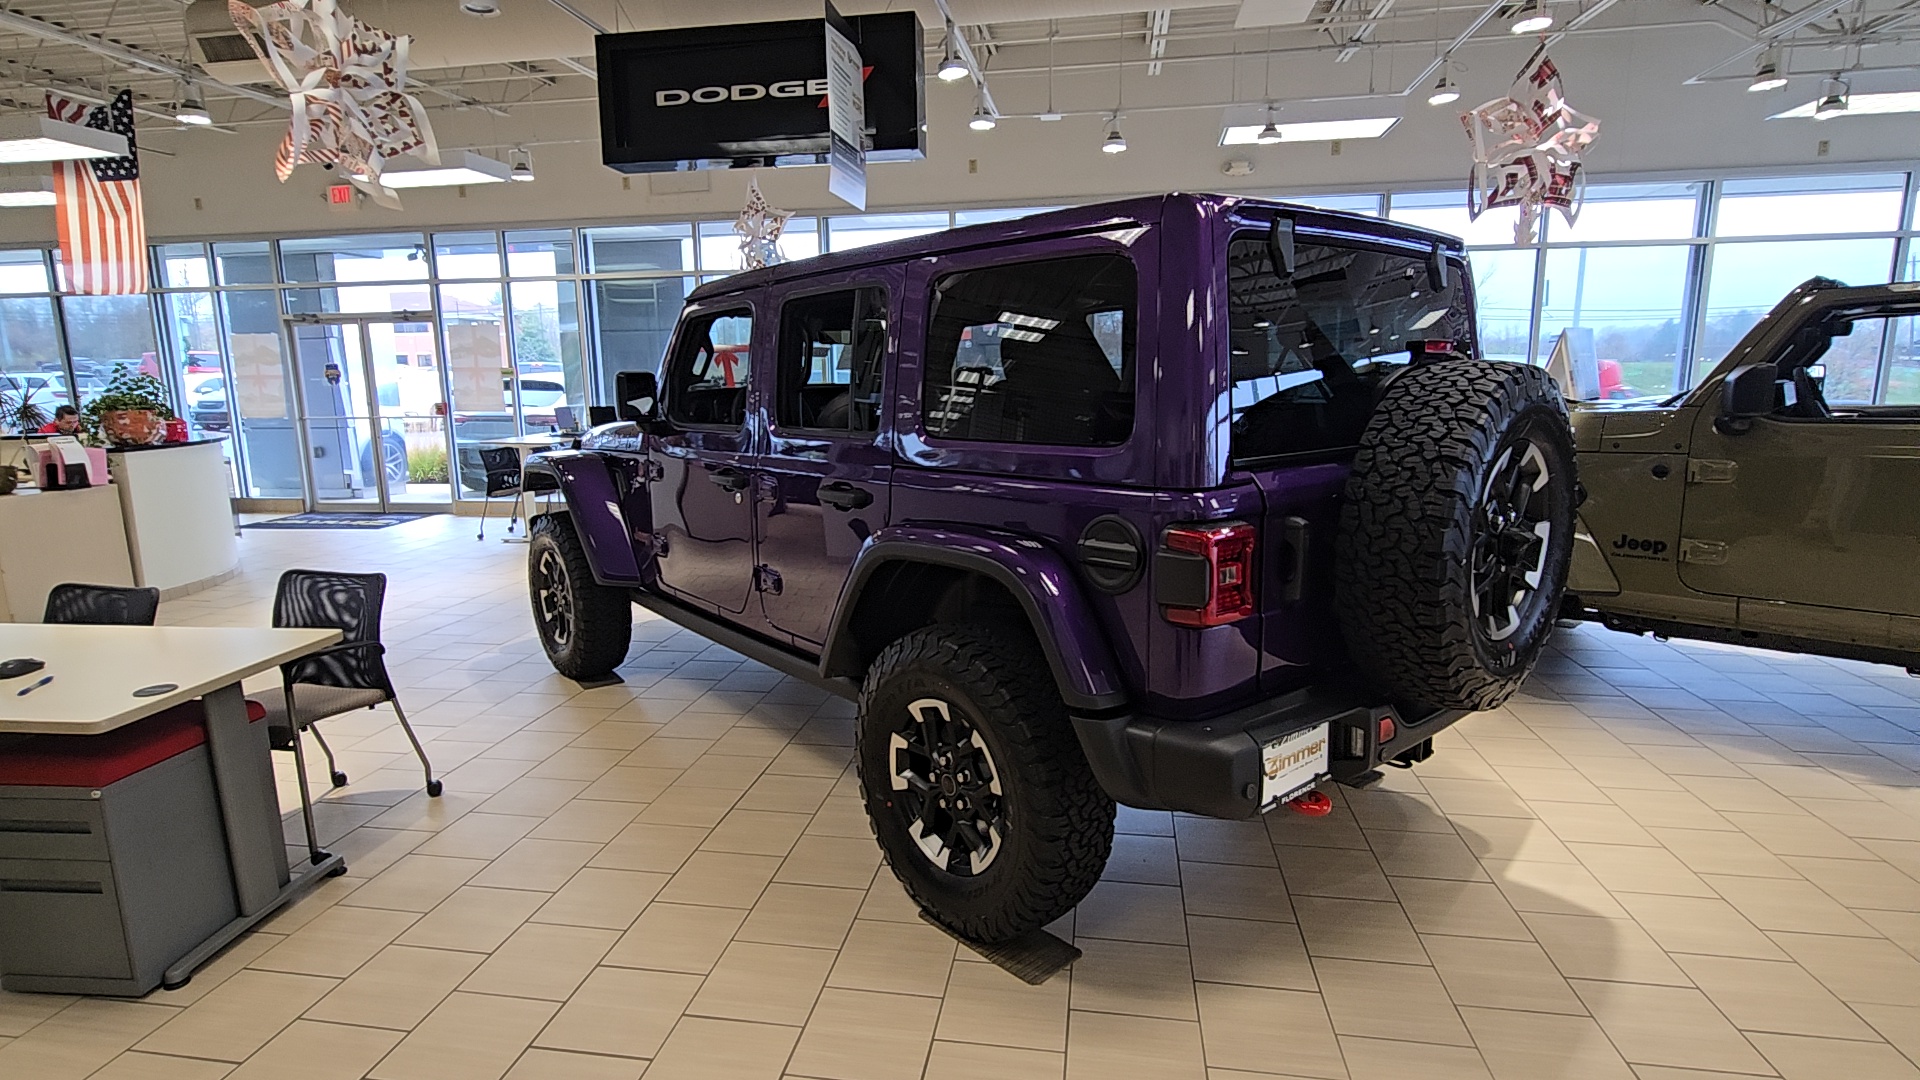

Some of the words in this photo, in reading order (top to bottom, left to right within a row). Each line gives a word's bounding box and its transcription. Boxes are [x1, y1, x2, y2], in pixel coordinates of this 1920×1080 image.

[331, 187, 350, 203] EXIT
[1612, 534, 1667, 555] Jeep
[1265, 738, 1326, 777] Zimmer
[1281, 782, 1317, 804] FLORENCE
